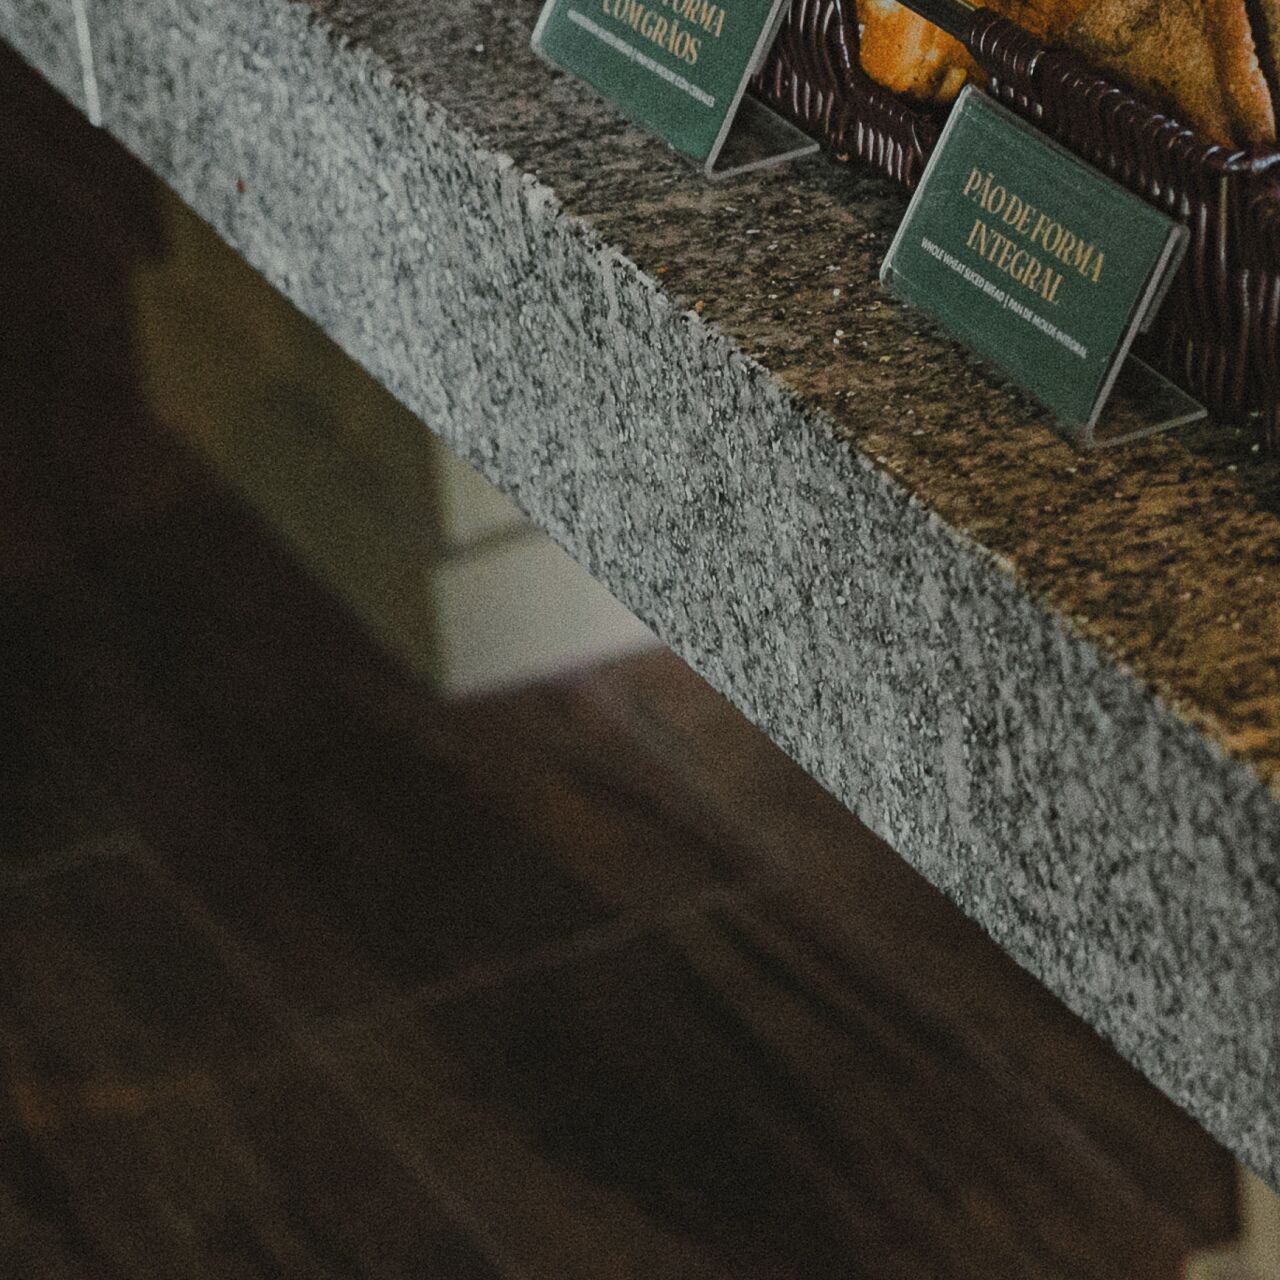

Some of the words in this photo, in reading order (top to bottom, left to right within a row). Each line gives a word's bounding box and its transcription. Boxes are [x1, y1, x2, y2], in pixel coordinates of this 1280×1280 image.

[641, 11, 702, 65] GRÃOS
[962, 167, 1006, 214] PÃO
[1002, 194, 1037, 235] DE
[1030, 213, 1105, 283] FORMA
[966, 219, 1064, 305] INTEGRAL
[921, 236, 945, 261] WHOLE
[943, 252, 966, 275] WHEAT
[983, 280, 1005, 302] BREAD
